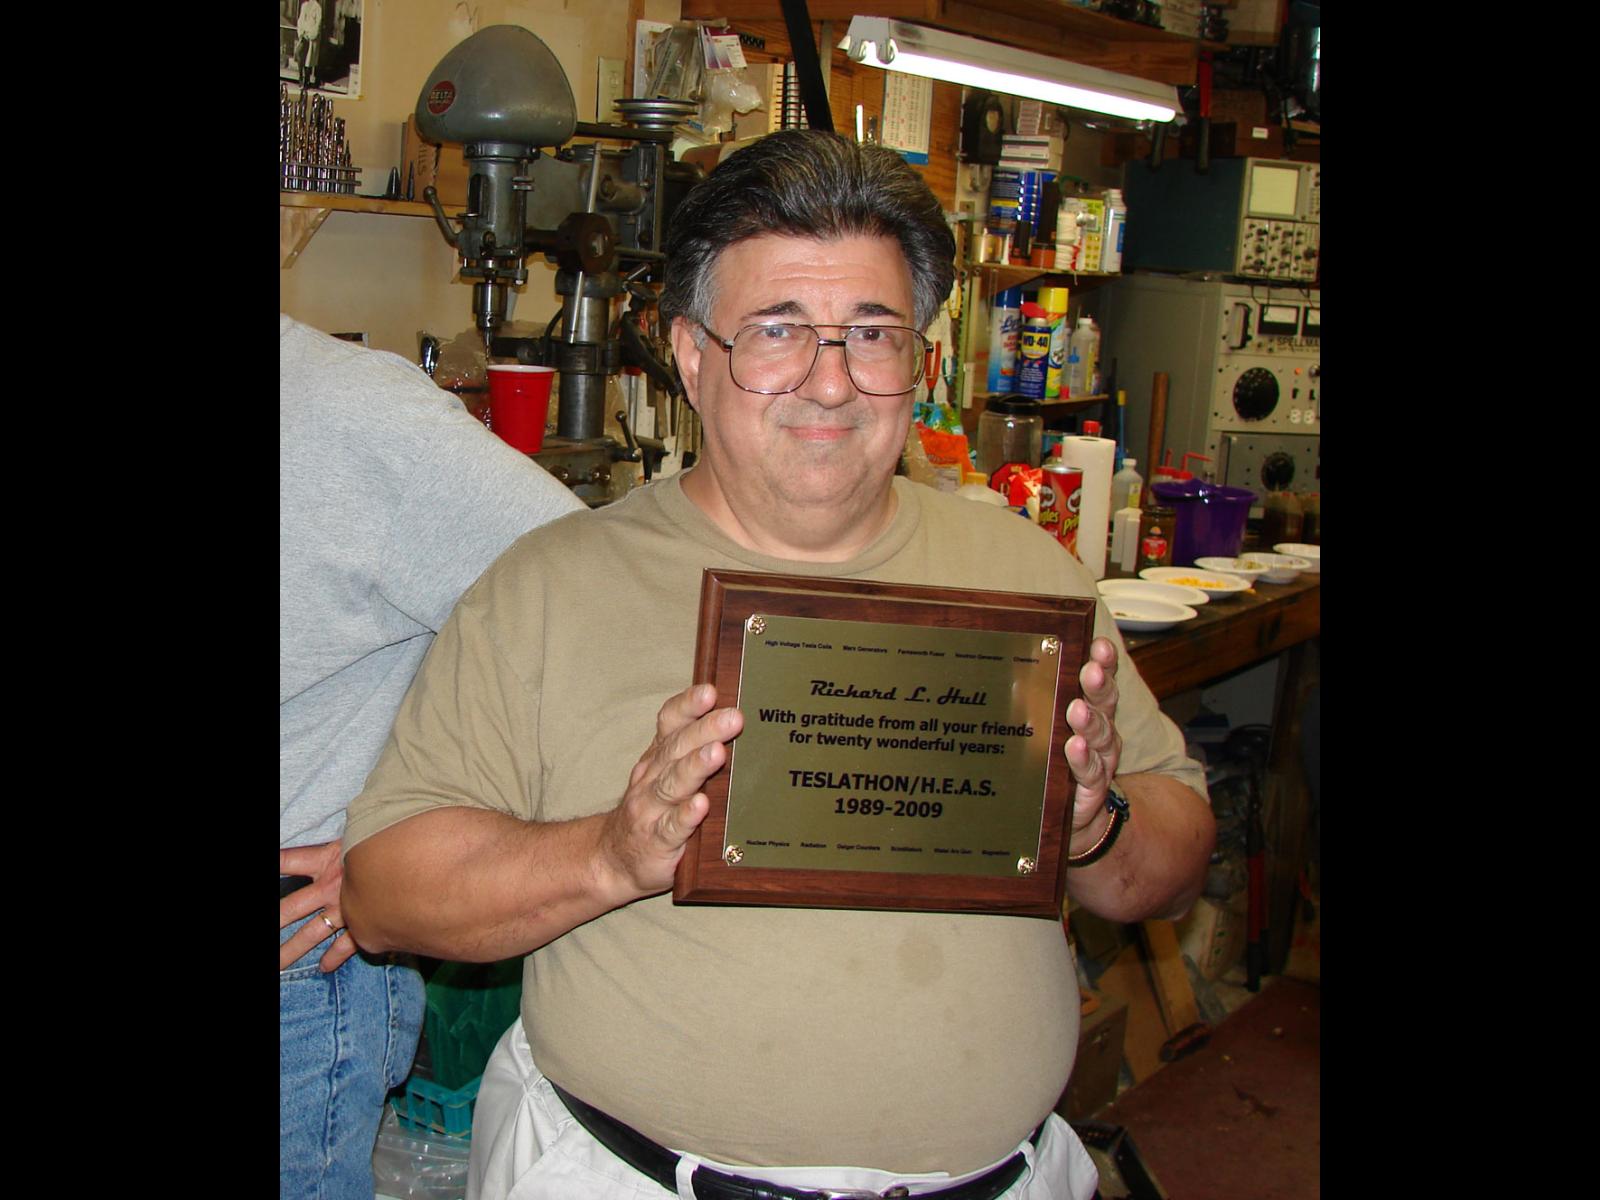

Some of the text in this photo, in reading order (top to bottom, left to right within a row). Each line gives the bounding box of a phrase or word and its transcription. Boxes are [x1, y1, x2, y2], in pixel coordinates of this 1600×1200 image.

[1022, 335, 1049, 348] WD-40
[811, 680, 987, 706] Richard L. Hull
[759, 709, 1034, 737] With gratitude from all your friends
[789, 730, 1005, 755] for twenty wonderful years:
[789, 770, 996, 797] TESLATHON/H.E.A.S.
[834, 798, 943, 818] 1989-2009
